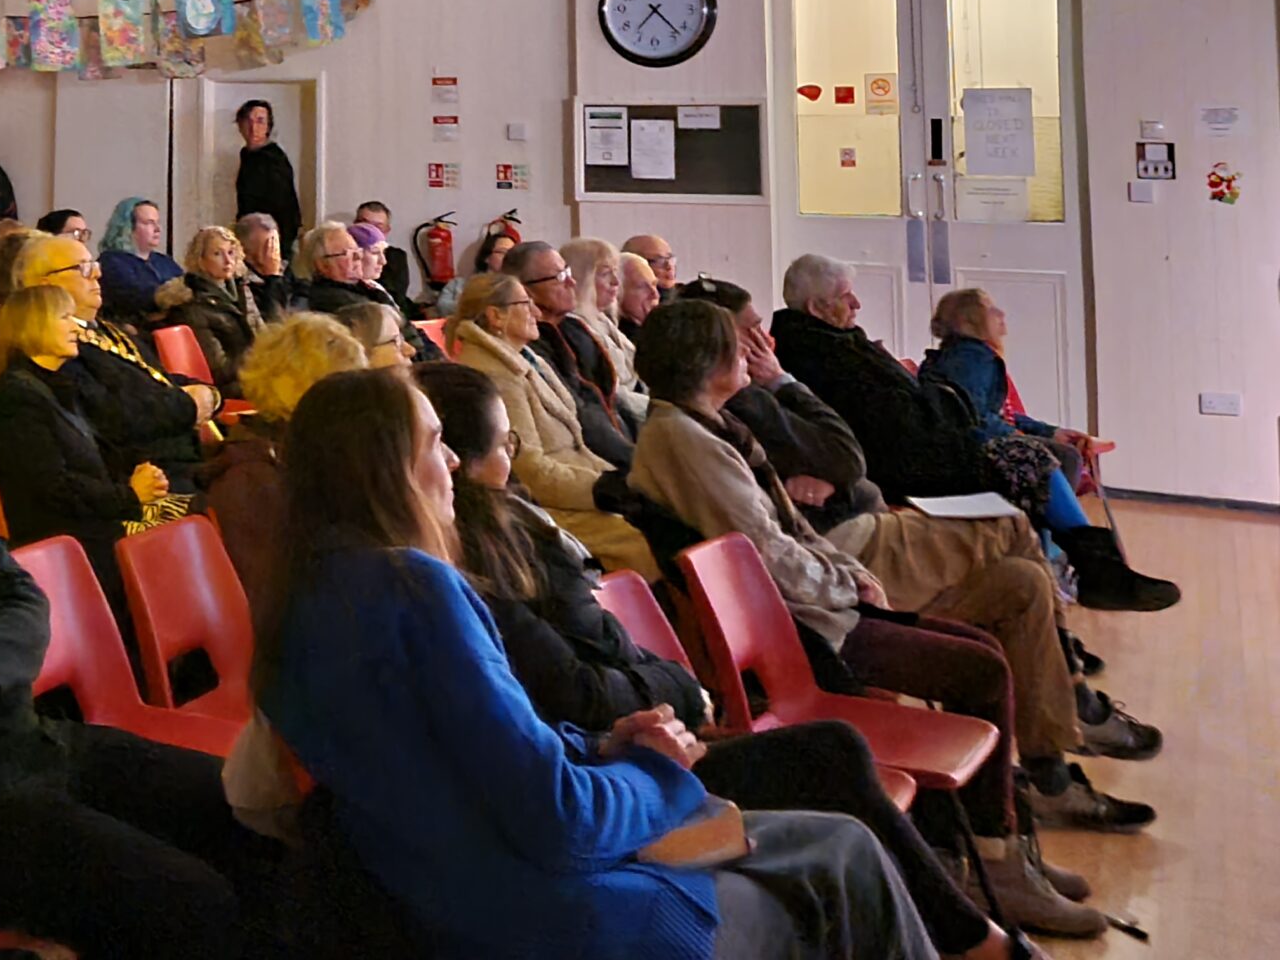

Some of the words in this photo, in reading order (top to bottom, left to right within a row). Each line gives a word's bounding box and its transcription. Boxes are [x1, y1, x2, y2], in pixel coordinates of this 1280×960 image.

[617, 4, 626, 14] 9
[688, 5, 694, 15] 3
[622, 20, 631, 31] 8
[680, 20, 687, 31] 4
[650, 36, 660, 47] 6
[973, 118, 1024, 131] CLOSED
[986, 133, 1017, 144] NEXT
